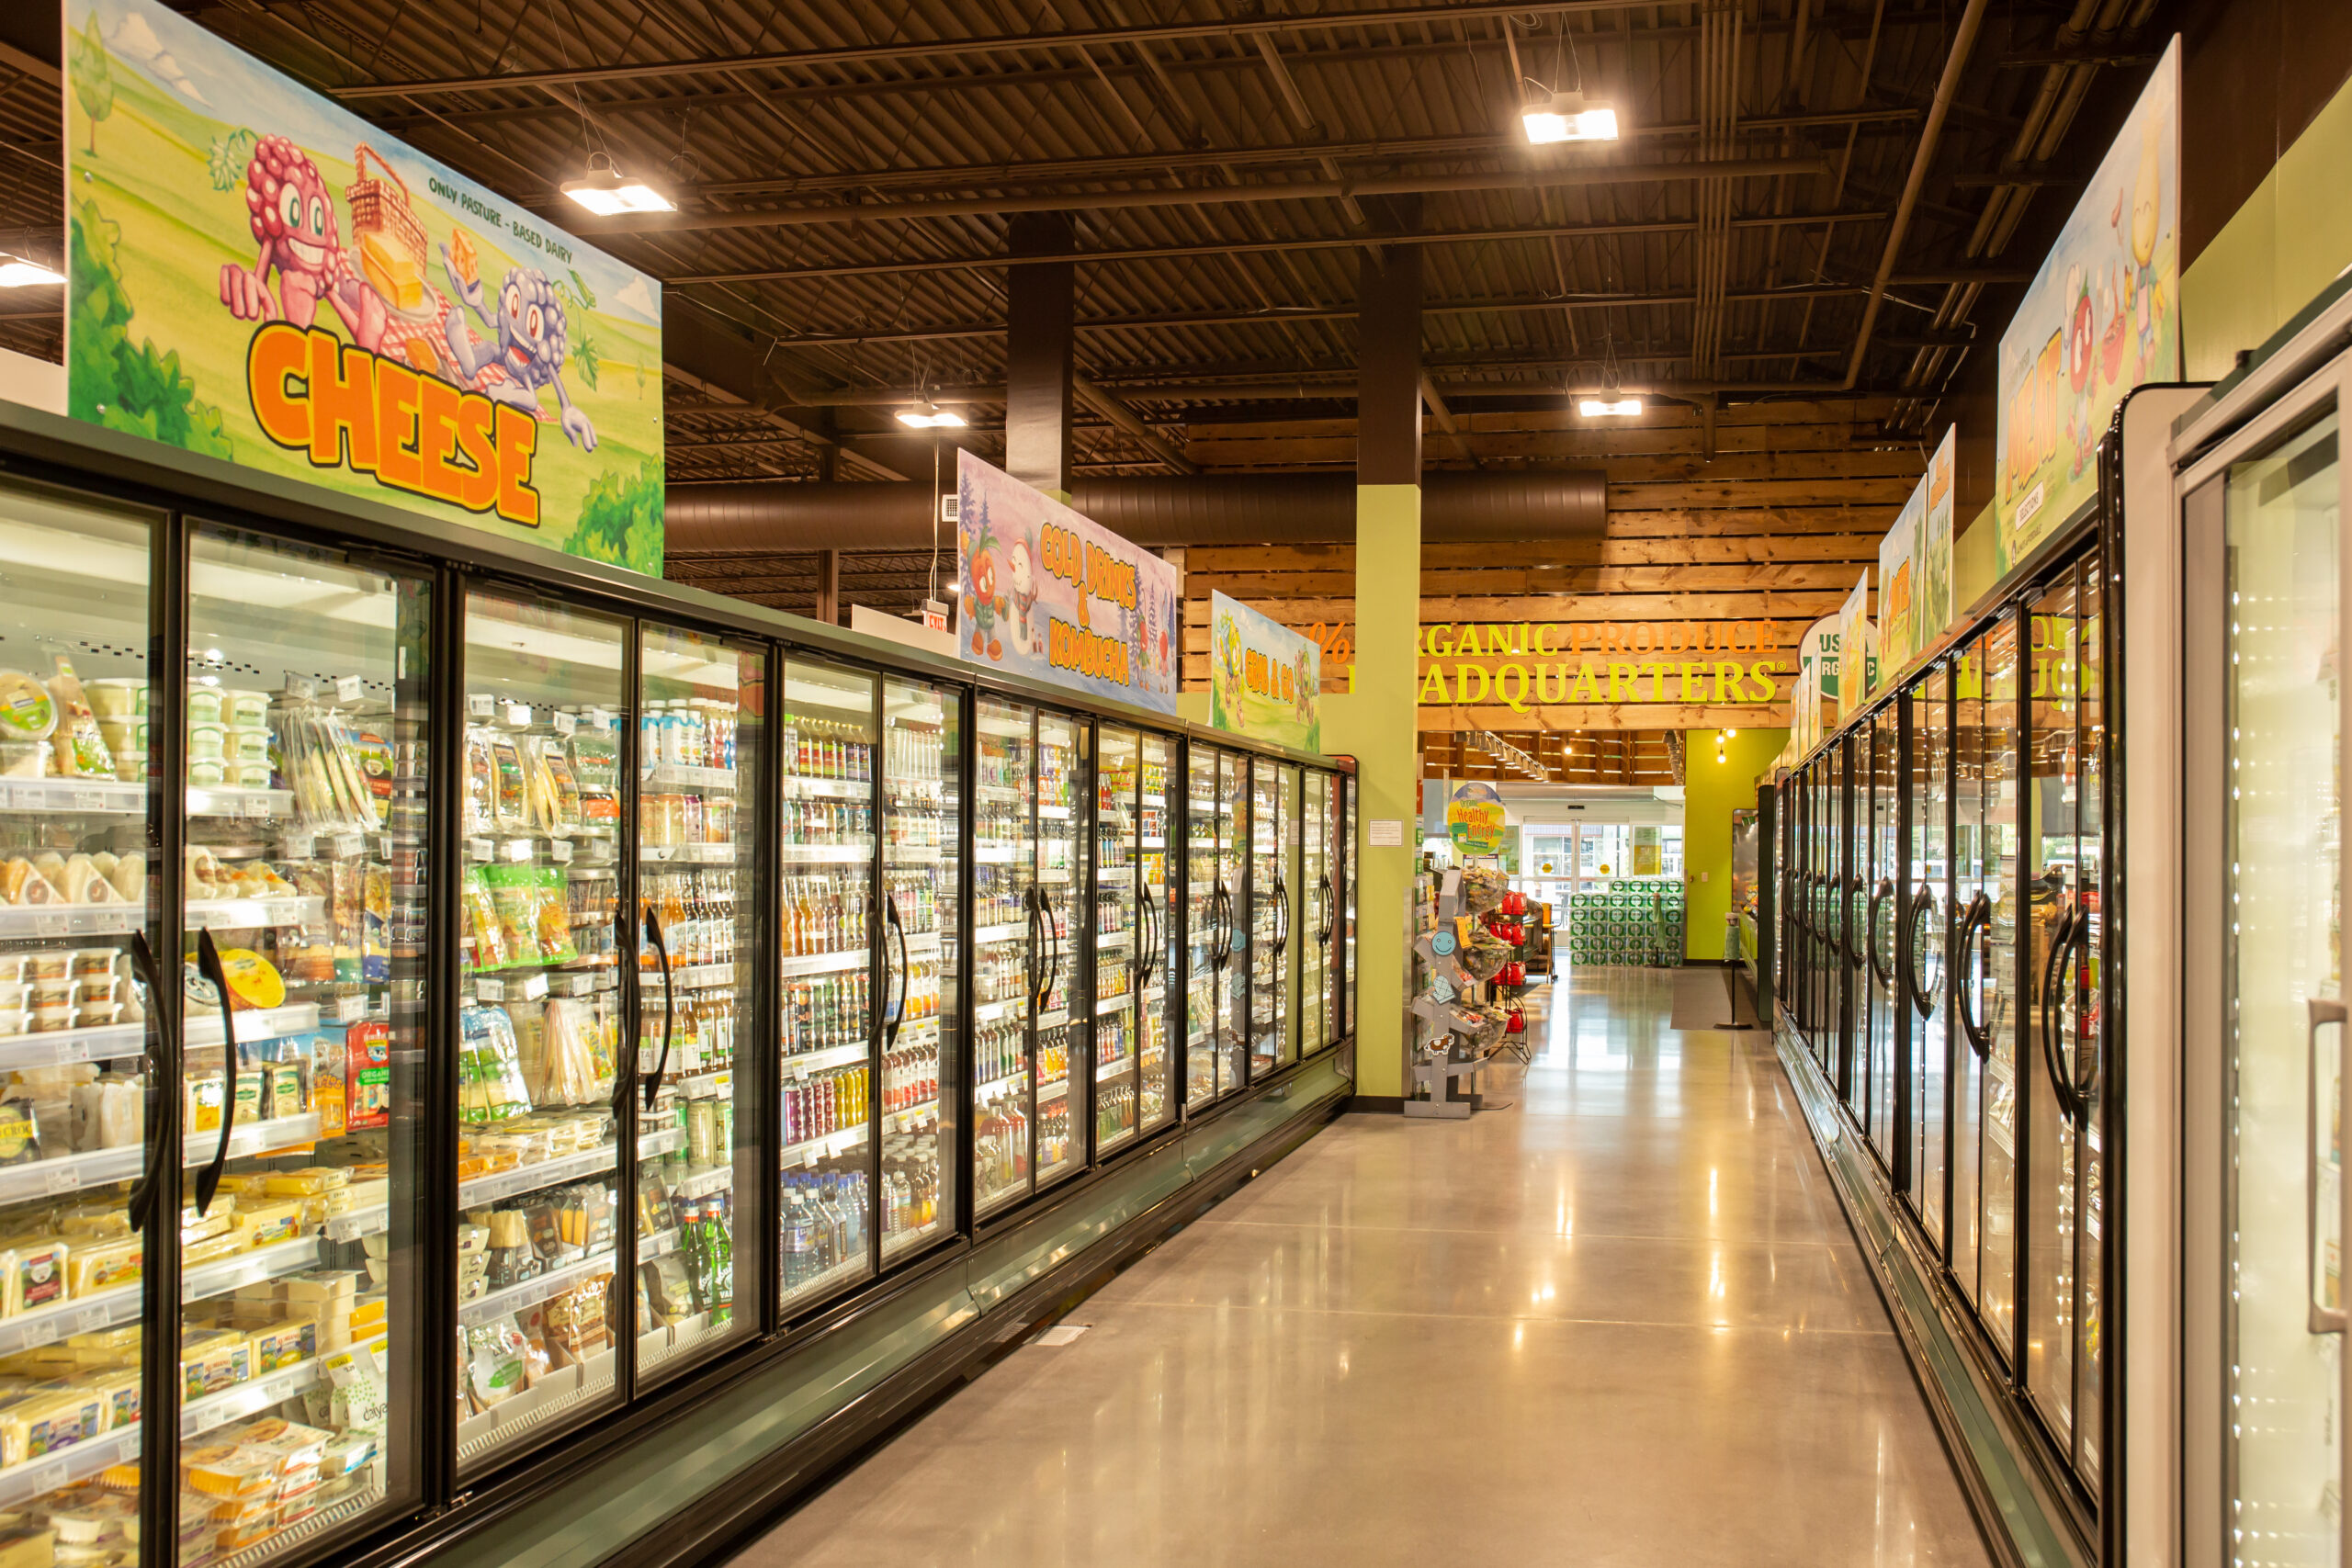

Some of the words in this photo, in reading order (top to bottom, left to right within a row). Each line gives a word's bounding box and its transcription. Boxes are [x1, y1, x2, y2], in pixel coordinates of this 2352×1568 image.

[429, 177, 458, 204] ONLY
[461, 193, 502, 228] PASTURE
[513, 220, 542, 248] BASED
[546, 238, 572, 265] DAIRY
[248, 321, 541, 528] CHEESE
[2006, 327, 2062, 505] MEAT
[1040, 522, 1082, 588] COLD
[1086, 540, 1137, 612] DRINKS
[1078, 581, 1091, 628] &
[1049, 616, 1129, 687] KOMBUCHA
[1419, 623, 1558, 658] GANIC
[1569, 620, 1779, 656] PRODUCE
[1245, 648, 1269, 695] GRAB
[1281, 663, 1295, 705] GO
[1457, 808, 1488, 824] Healthy
[1467, 824, 1495, 840] Energy
